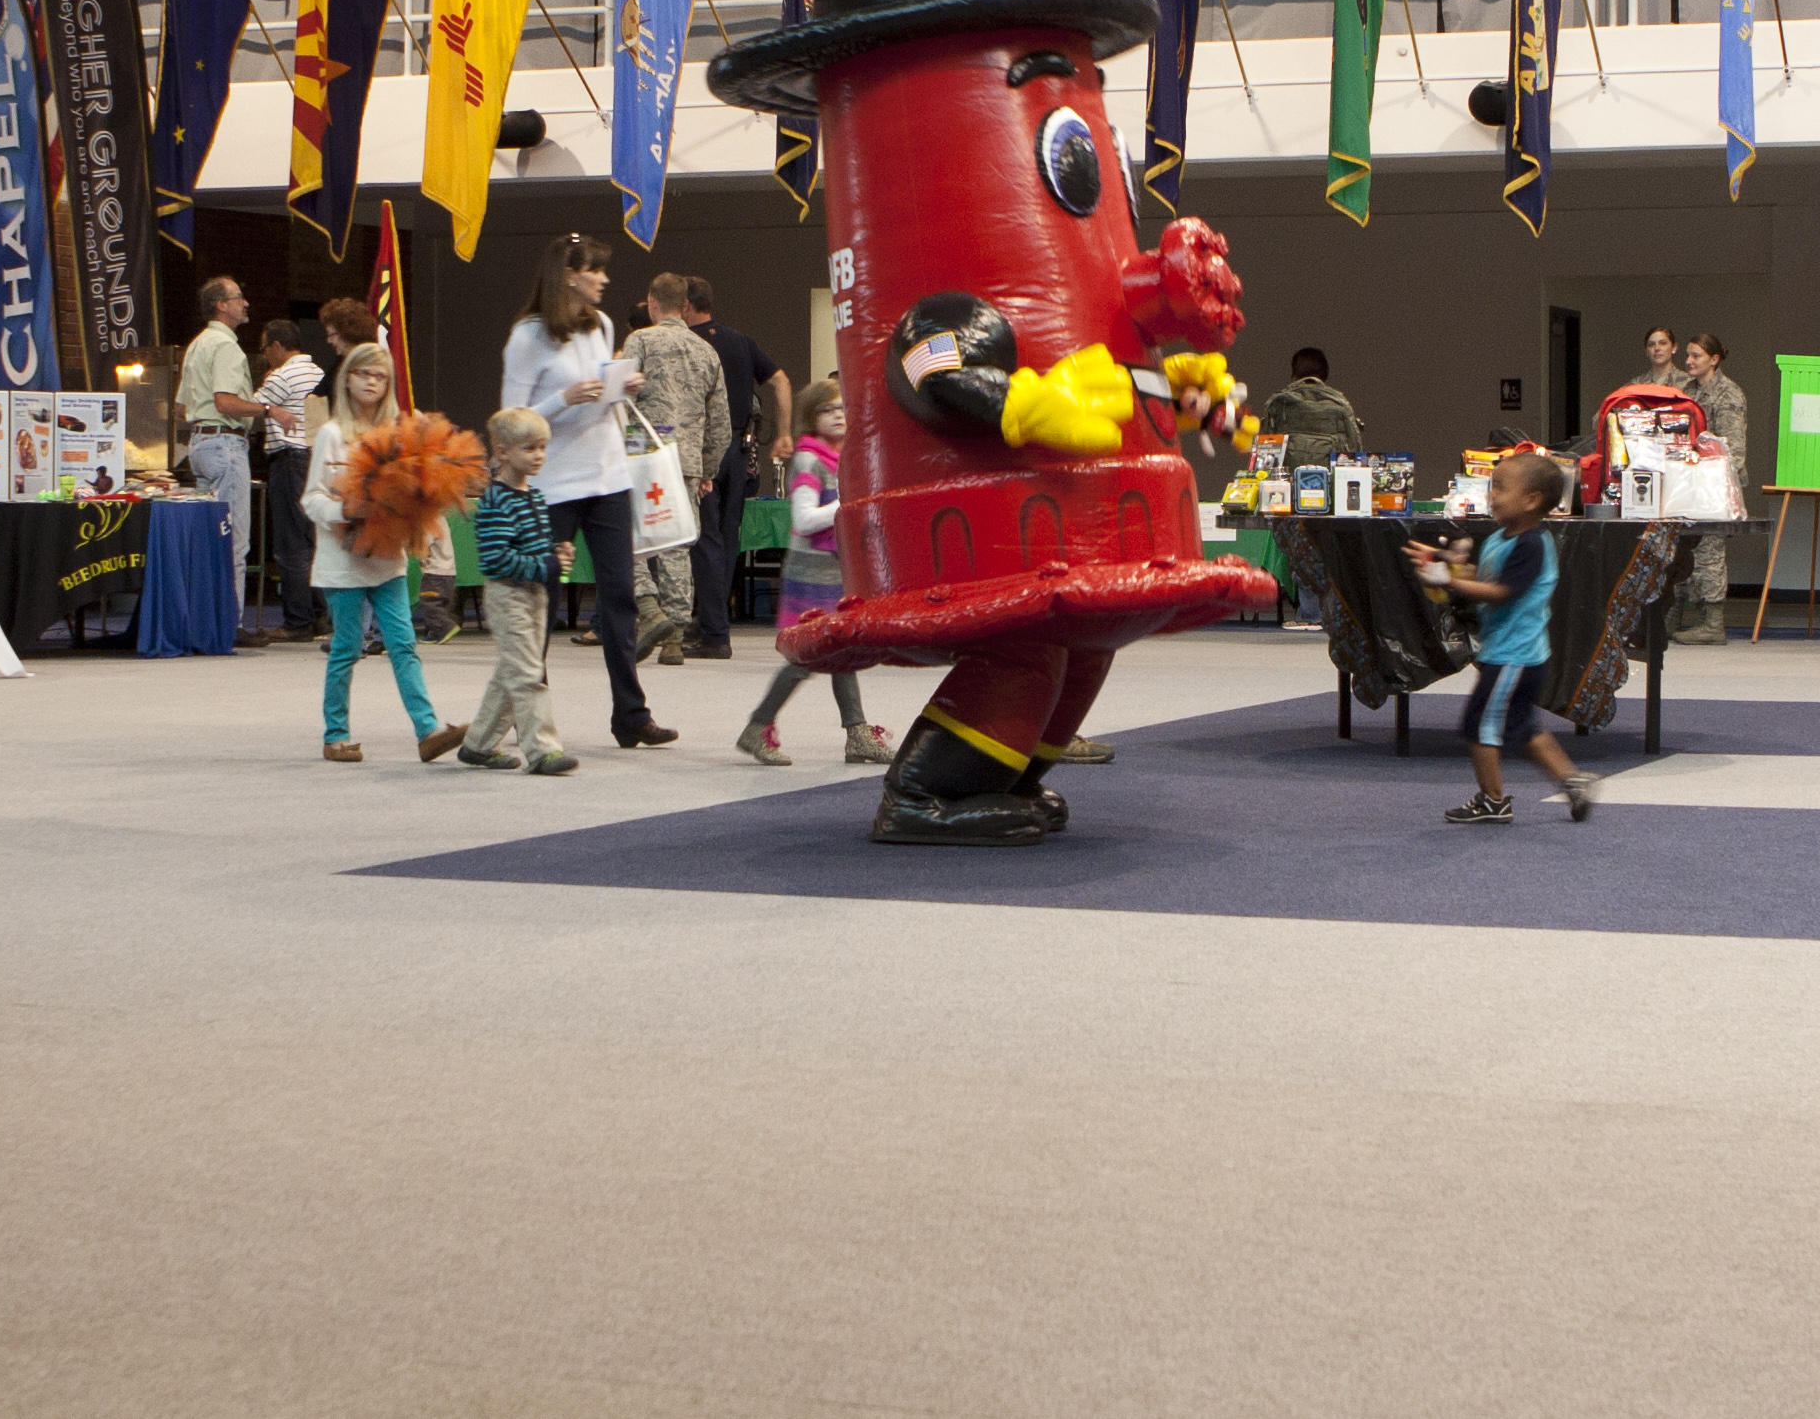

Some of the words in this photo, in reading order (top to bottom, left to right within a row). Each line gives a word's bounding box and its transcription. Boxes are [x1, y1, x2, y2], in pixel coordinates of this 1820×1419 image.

[69, 63, 81, 102] who
[70, 105, 85, 141] you
[78, 147, 88, 175] are
[81, 180, 95, 216] and
[83, 220, 100, 273] reach
[89, 130, 139, 351] GROUNDS
[88, 276, 106, 297] for
[94, 305, 110, 354] more
